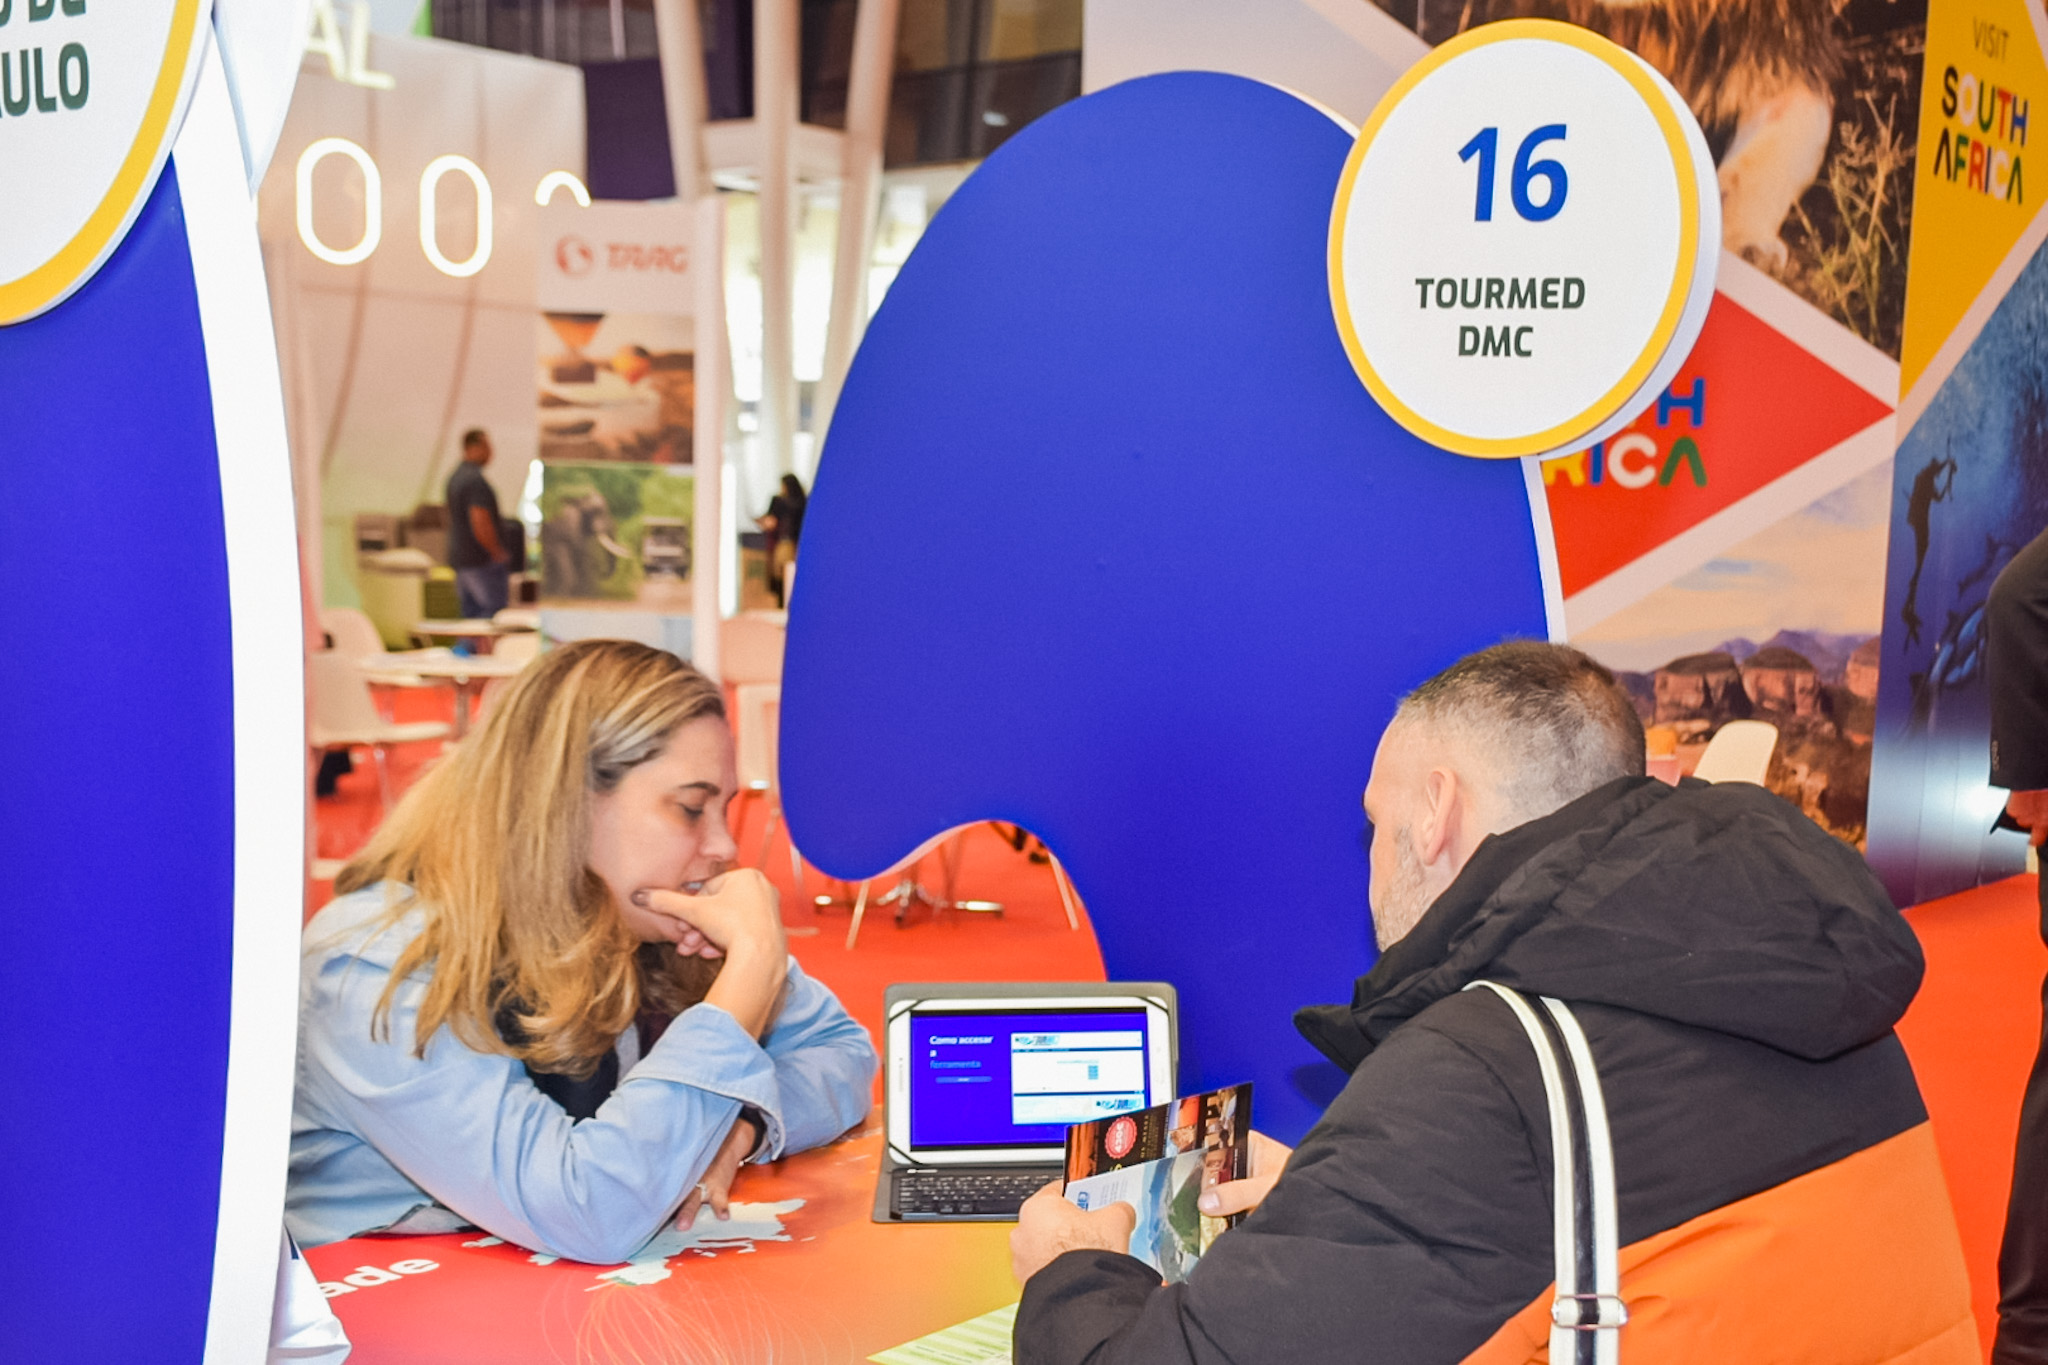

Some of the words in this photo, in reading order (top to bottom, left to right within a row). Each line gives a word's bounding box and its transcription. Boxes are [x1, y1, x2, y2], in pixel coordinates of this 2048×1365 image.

[1973, 17, 2009, 62] VISIT
[0, 42, 89, 118] ULO
[1942, 64, 2029, 147] SOUTH
[1458, 124, 1568, 222] 16
[1415, 277, 1586, 309] TOURMED
[1458, 325, 1534, 357] DMC
[929, 1035, 958, 1045] Como
